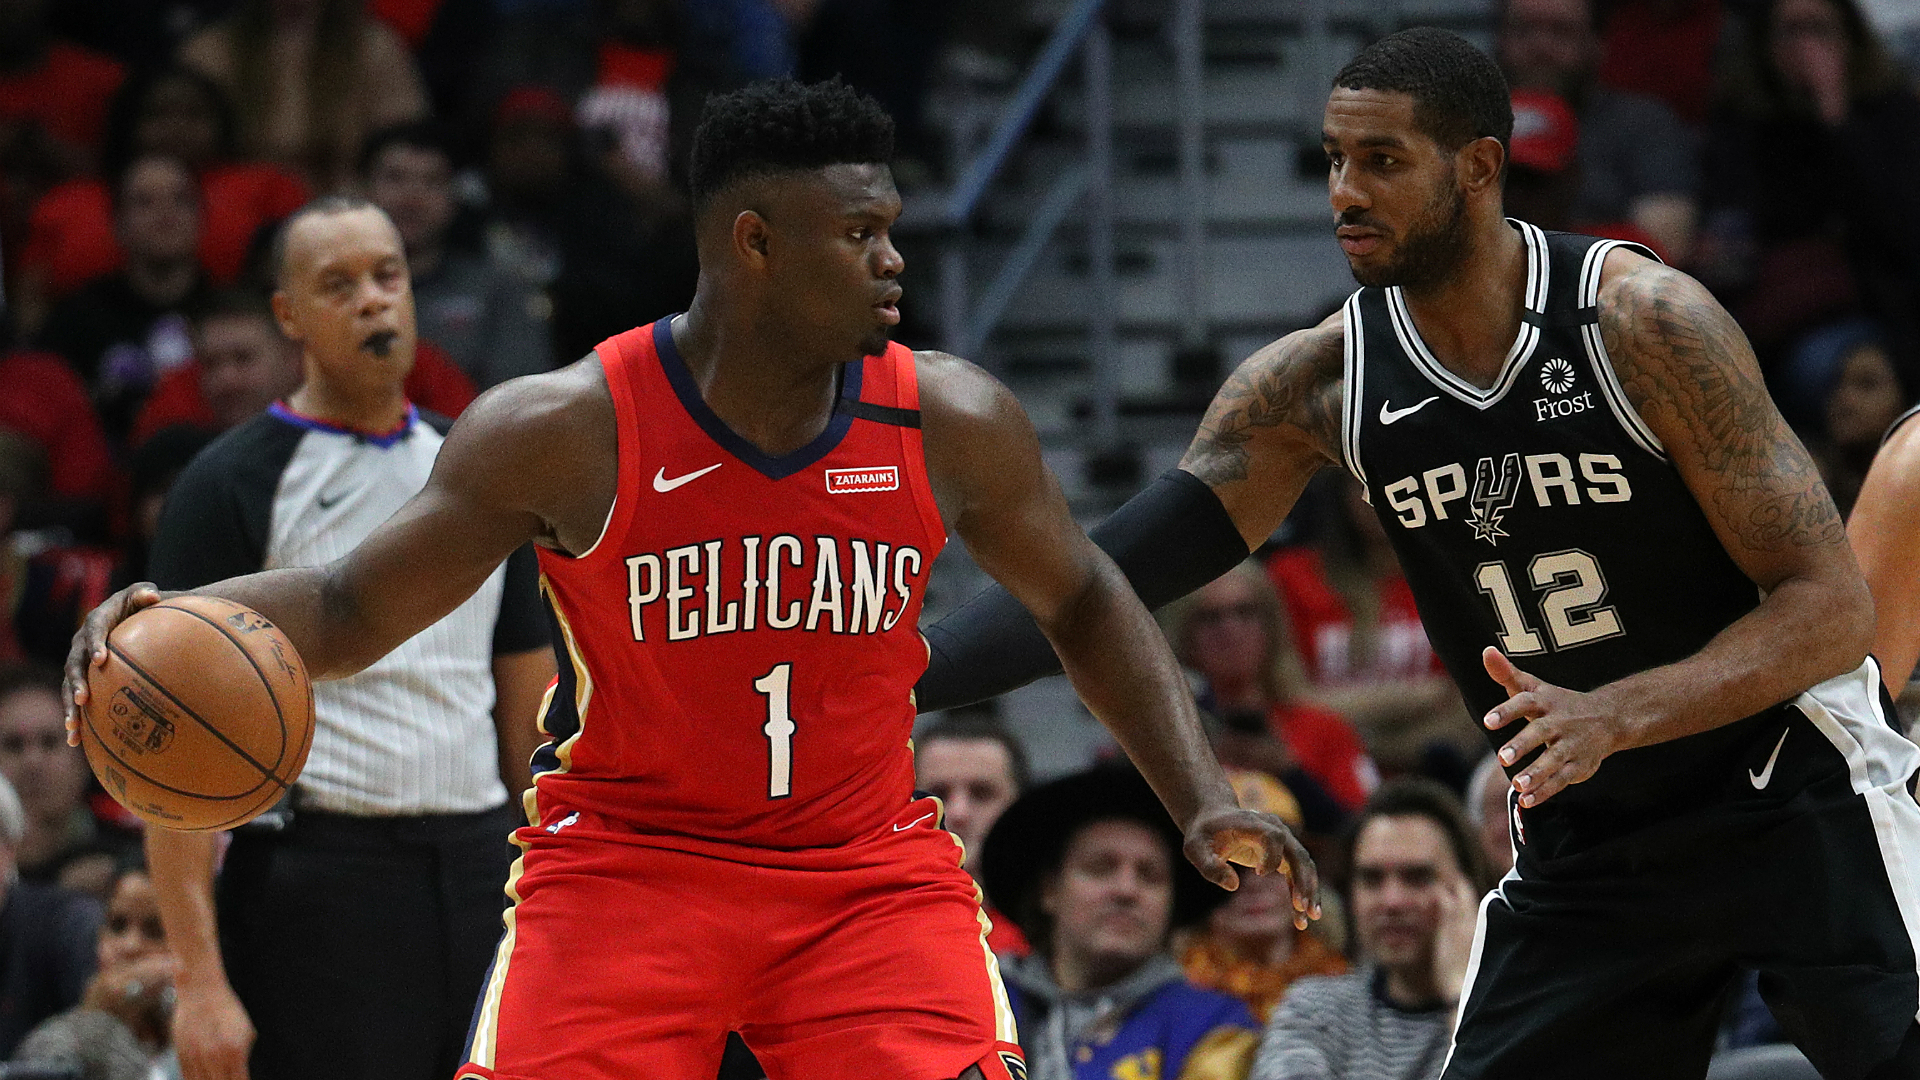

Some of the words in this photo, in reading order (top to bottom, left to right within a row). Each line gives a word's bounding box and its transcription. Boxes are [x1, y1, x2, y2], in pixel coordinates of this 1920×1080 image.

[1533, 390, 1595, 422] Frost
[1384, 452, 1632, 546] SPURS
[624, 533, 922, 643] PELICANS
[1473, 548, 1627, 657] 12
[752, 661, 798, 800] 1
